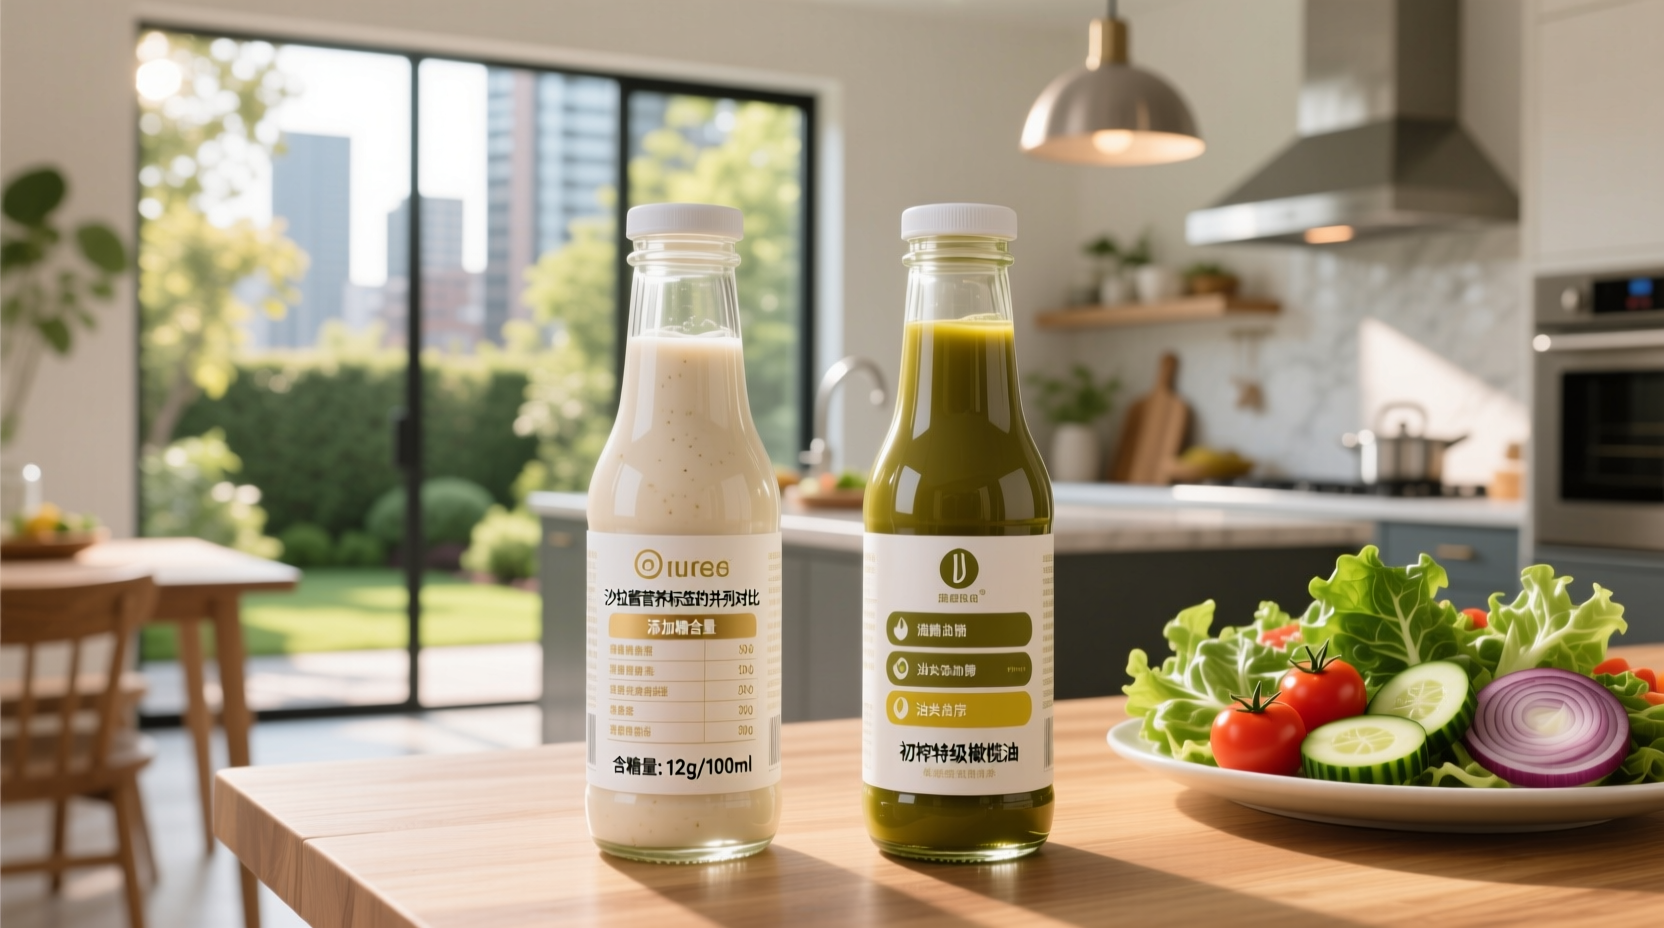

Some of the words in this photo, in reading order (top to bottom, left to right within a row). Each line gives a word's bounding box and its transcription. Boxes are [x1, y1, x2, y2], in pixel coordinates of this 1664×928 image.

[899, 741, 1019, 764] 初榨特级橄榄油
[666, 755, 752, 780] 12g/100ml
